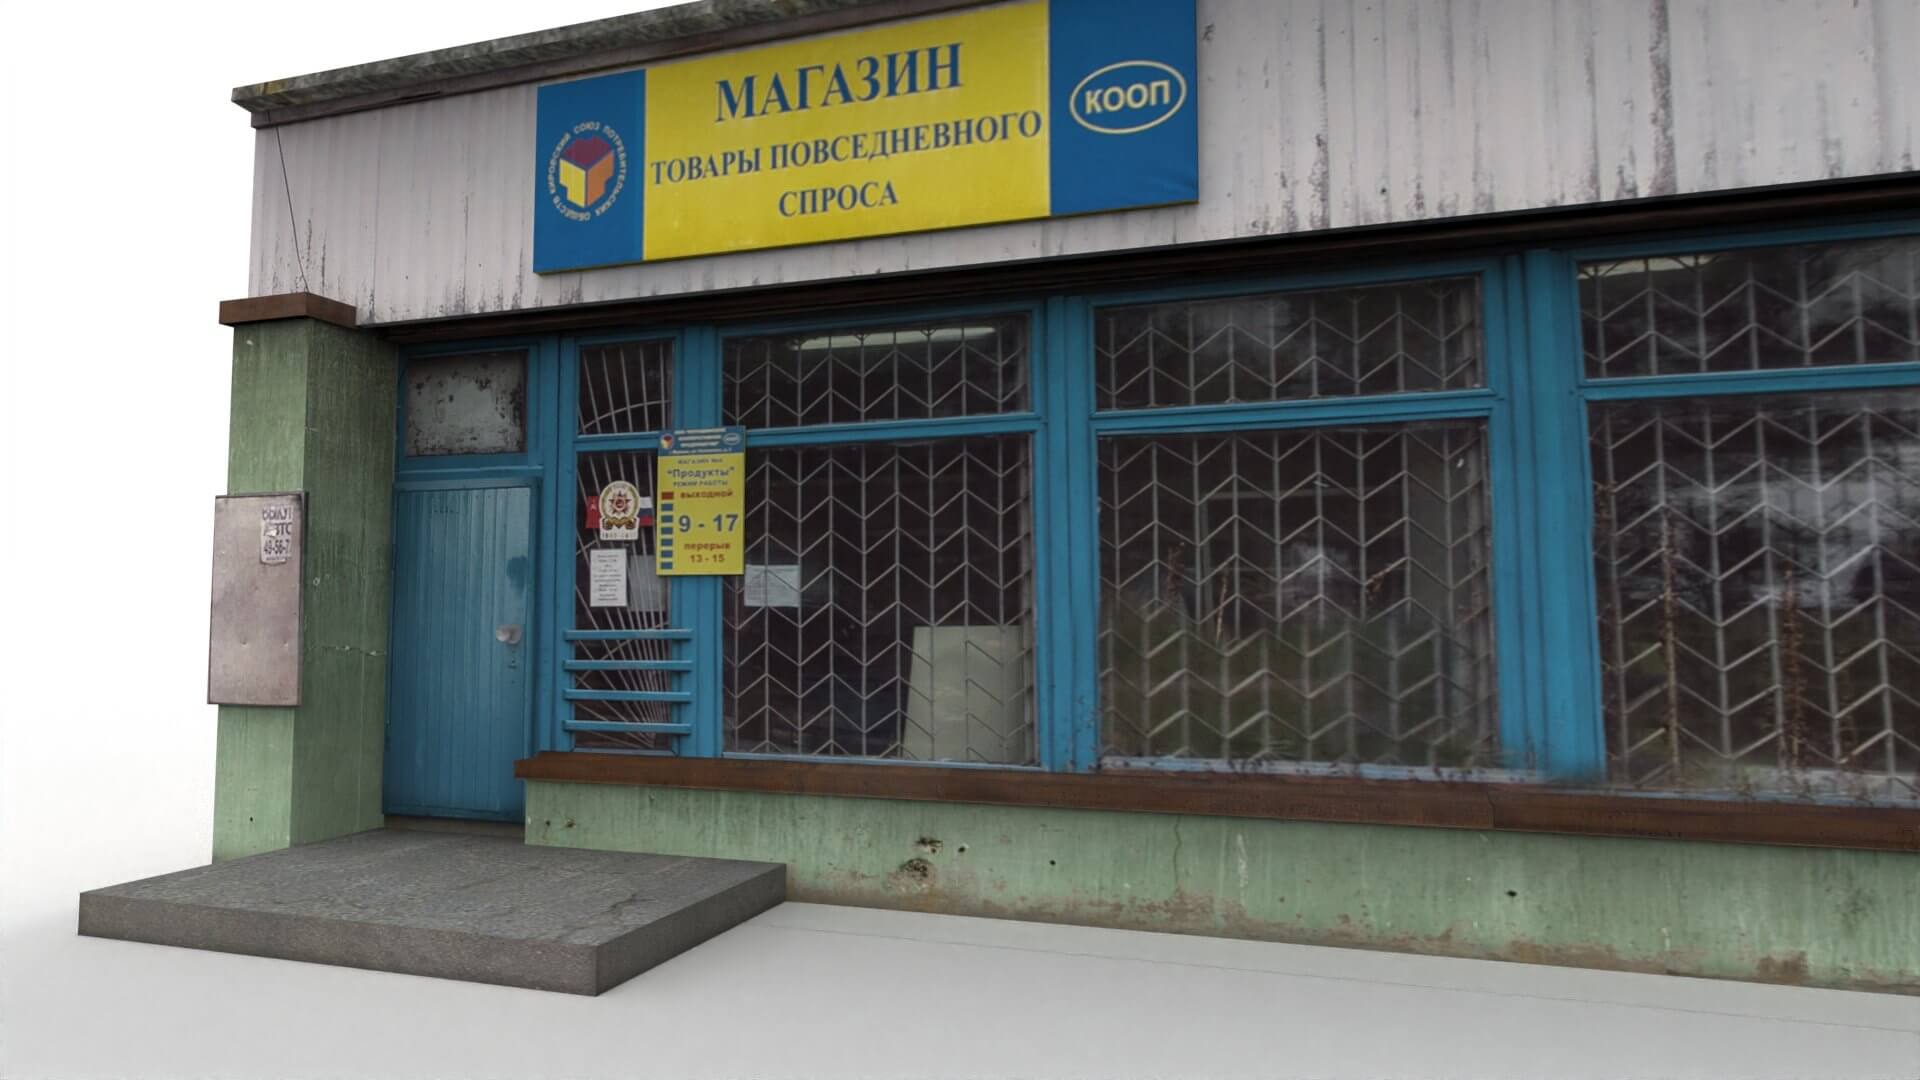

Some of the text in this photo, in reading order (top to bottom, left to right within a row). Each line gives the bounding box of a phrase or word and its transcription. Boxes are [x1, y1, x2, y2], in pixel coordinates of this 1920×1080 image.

[715, 43, 963, 122] МАГАЗИН
[1085, 80, 1170, 114] КООП
[651, 110, 1042, 185] ТОВАРЫ ПОВСЕДНЕВНОГО
[778, 181, 898, 217] СПРОСА
[678, 514, 691, 532] 9
[713, 513, 739, 532] 17
[690, 554, 702, 563] 13
[713, 553, 725, 563] 15
